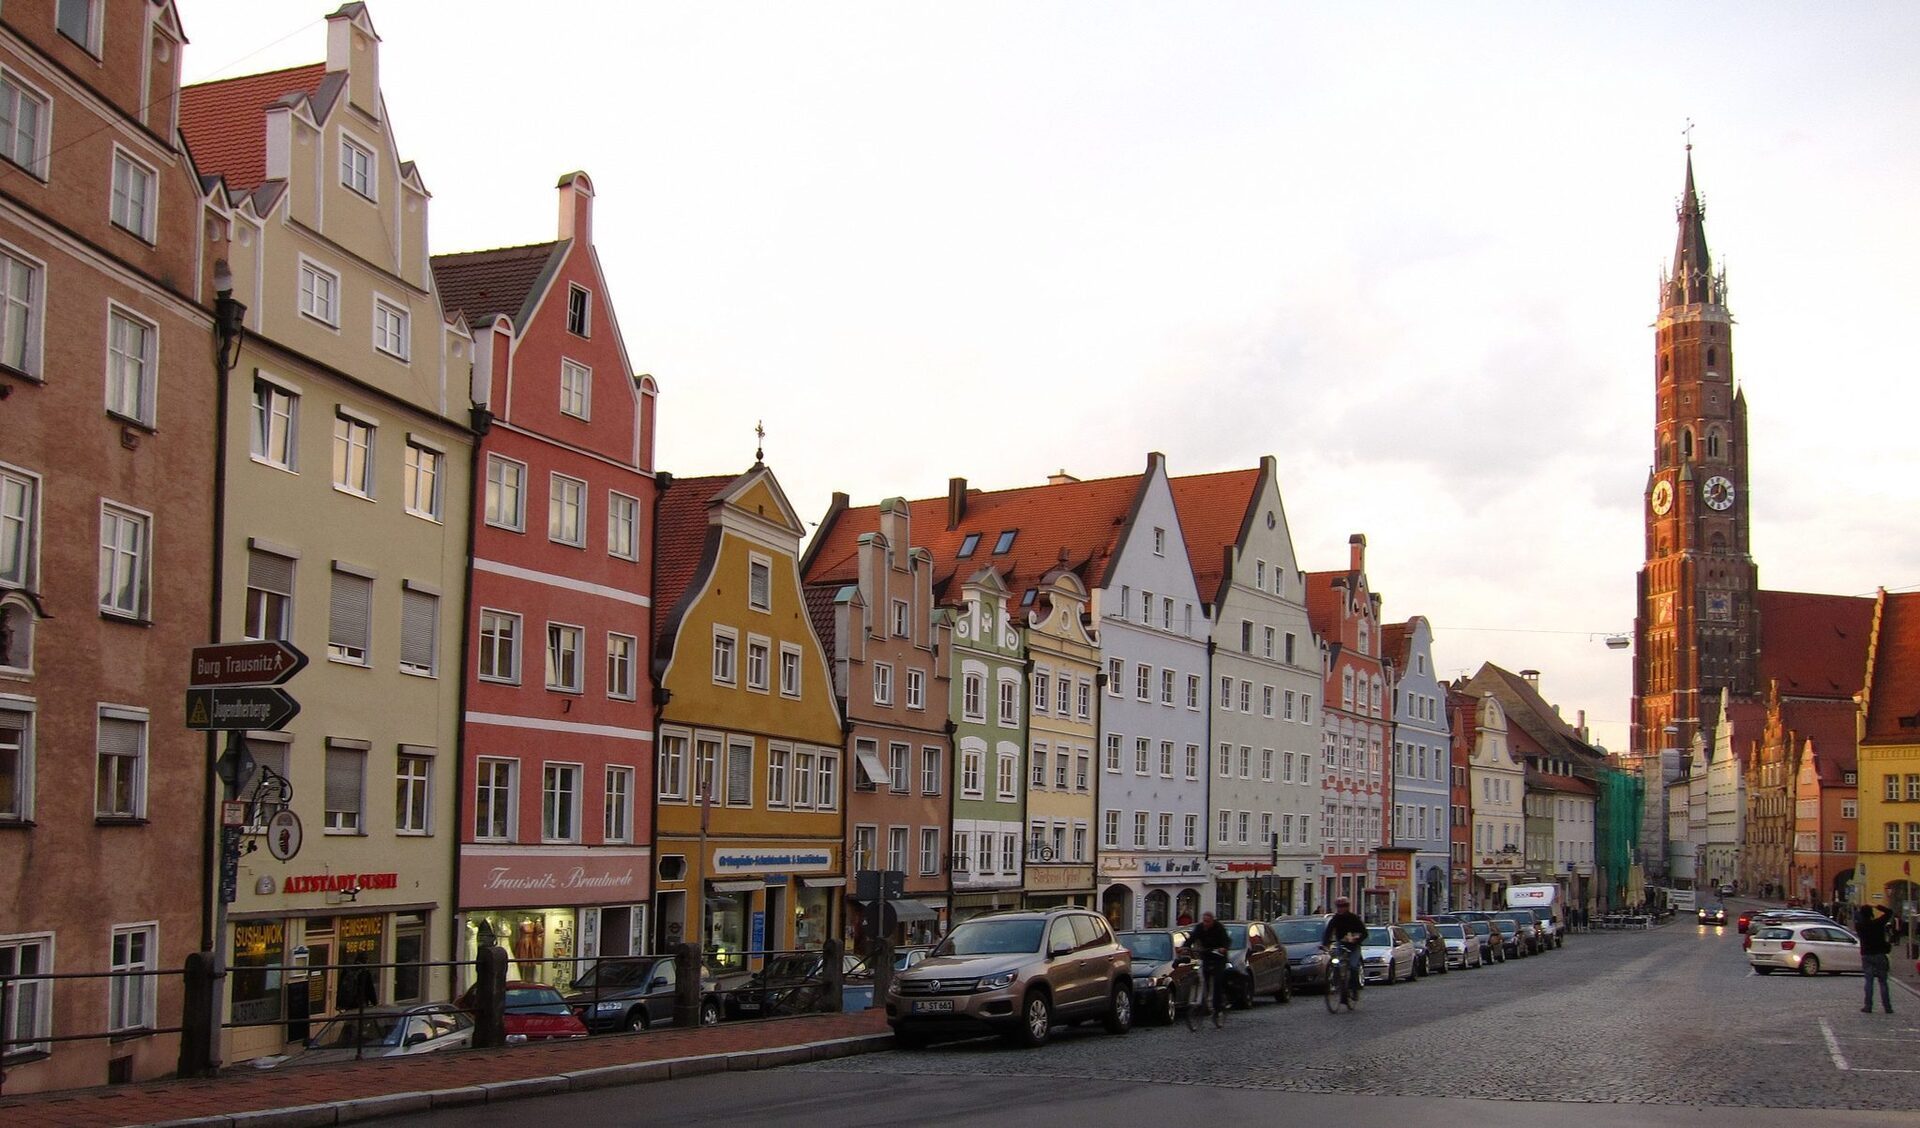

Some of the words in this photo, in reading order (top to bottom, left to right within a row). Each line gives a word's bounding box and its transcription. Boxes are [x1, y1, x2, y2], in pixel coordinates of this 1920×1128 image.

[197, 658, 221, 678] Burg
[226, 654, 273, 673] Trausnitz
[214, 699, 270, 722] Jugendherberge
[283, 874, 356, 894] ALTSTADT
[358, 873, 398, 890] SUSHI
[483, 866, 558, 890] Trausnitz
[561, 866, 633, 889] Brautmode
[341, 918, 382, 938] HEIMSERVICE
